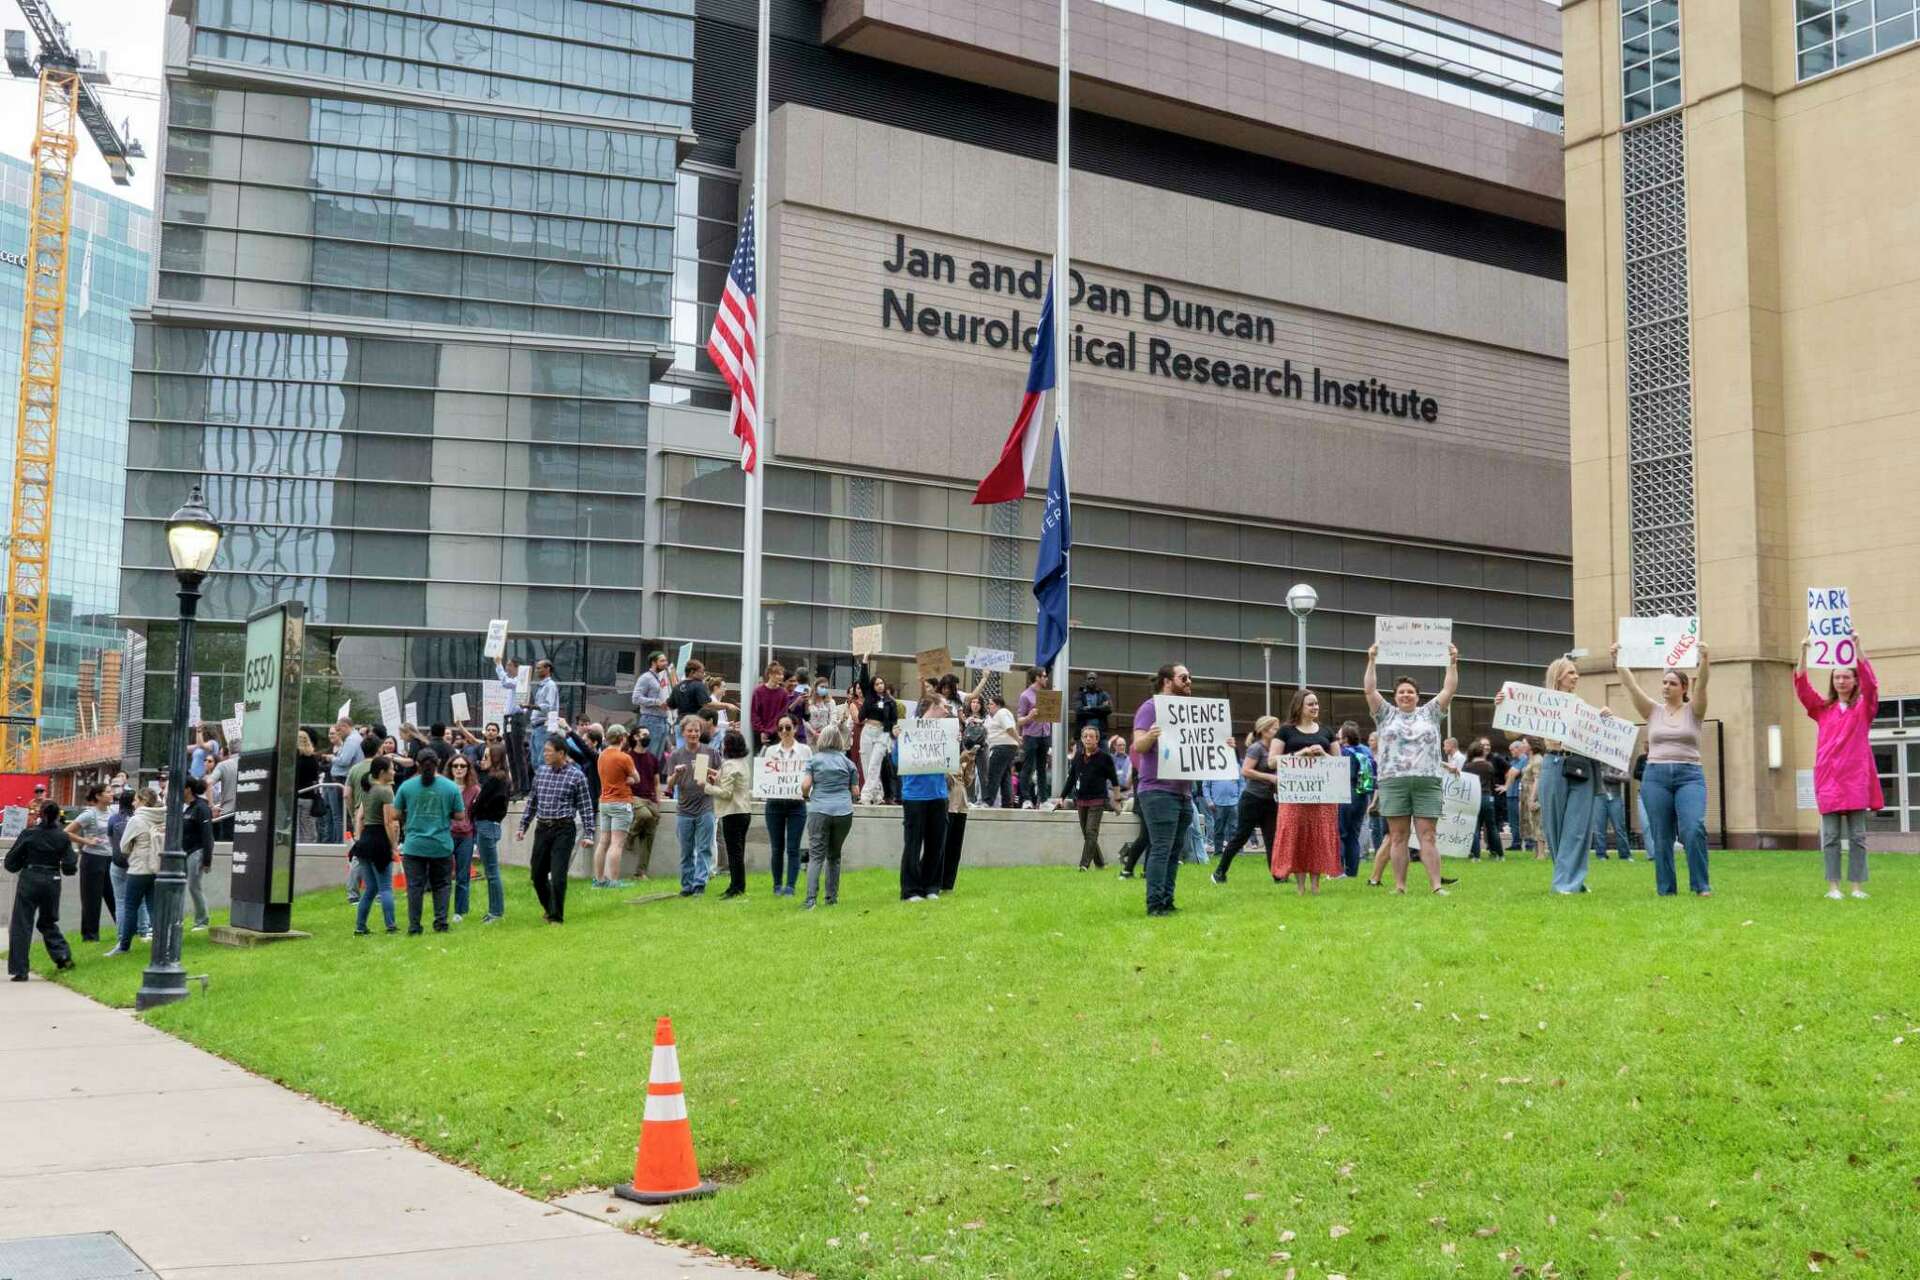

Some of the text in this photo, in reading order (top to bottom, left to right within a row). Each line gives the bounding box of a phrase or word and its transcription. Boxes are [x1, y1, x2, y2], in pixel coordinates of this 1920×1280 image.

[883, 234, 955, 283] Jan
[969, 259, 1042, 299] and
[1144, 283, 1275, 343] Duncan
[883, 288, 1438, 423] Neuroloical Research Institute
[1808, 590, 1848, 610] DARK
[1808, 616, 1854, 636] AGES
[1666, 633, 1696, 666] CURES
[1814, 639, 1855, 665] 2.0
[246, 653, 275, 693] 6550
[916, 719, 941, 729] MAKE
[1168, 703, 1224, 725] SCIENCE
[1504, 713, 1568, 736] REALITY
[904, 729, 948, 744] AMERICA
[1180, 727, 1215, 744] SAVES
[912, 743, 947, 758] SMART
[1179, 745, 1228, 773] LIVES
[765, 760, 802, 773] SCIEN
[1280, 757, 1317, 769] STOP
[1280, 780, 1325, 792] START
